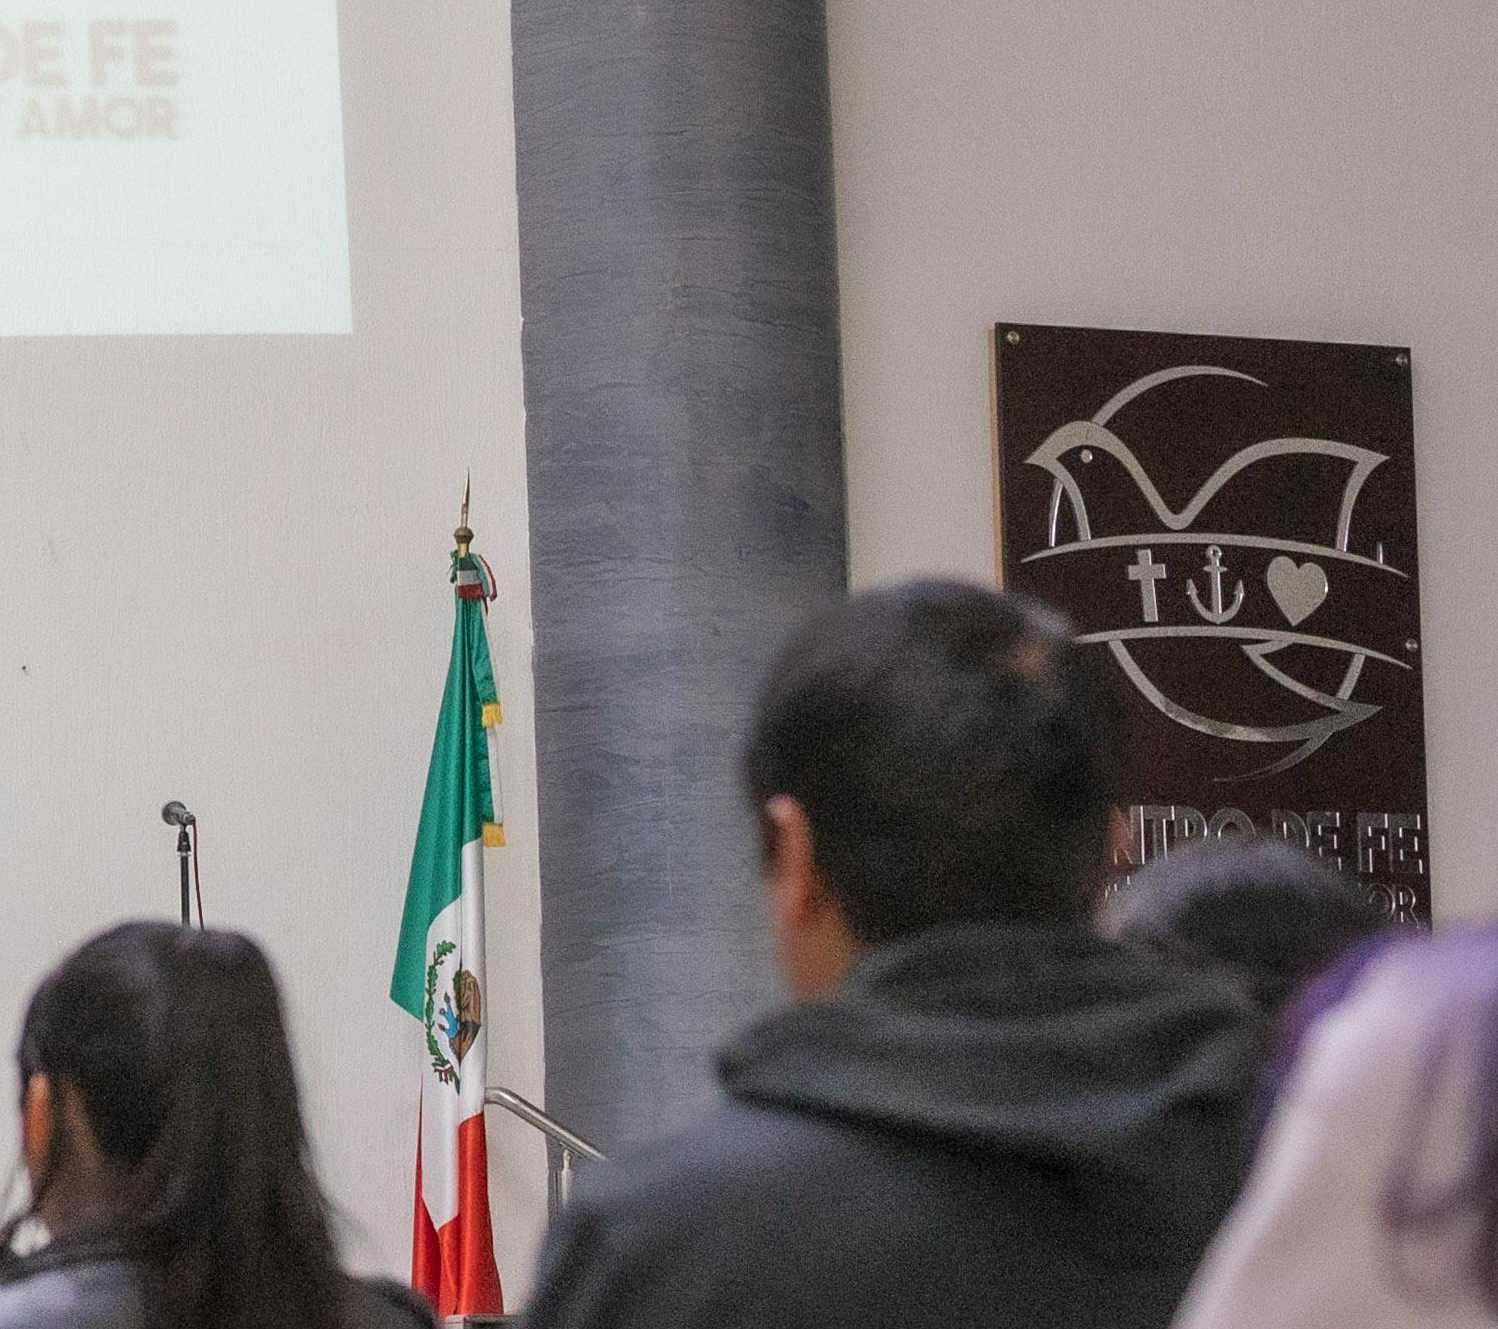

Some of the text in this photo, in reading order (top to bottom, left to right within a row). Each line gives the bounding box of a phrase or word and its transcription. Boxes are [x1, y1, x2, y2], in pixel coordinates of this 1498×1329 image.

[88, 19, 180, 88] FE
[15, 97, 180, 143] AMOR
[1356, 811, 1423, 874] FE
